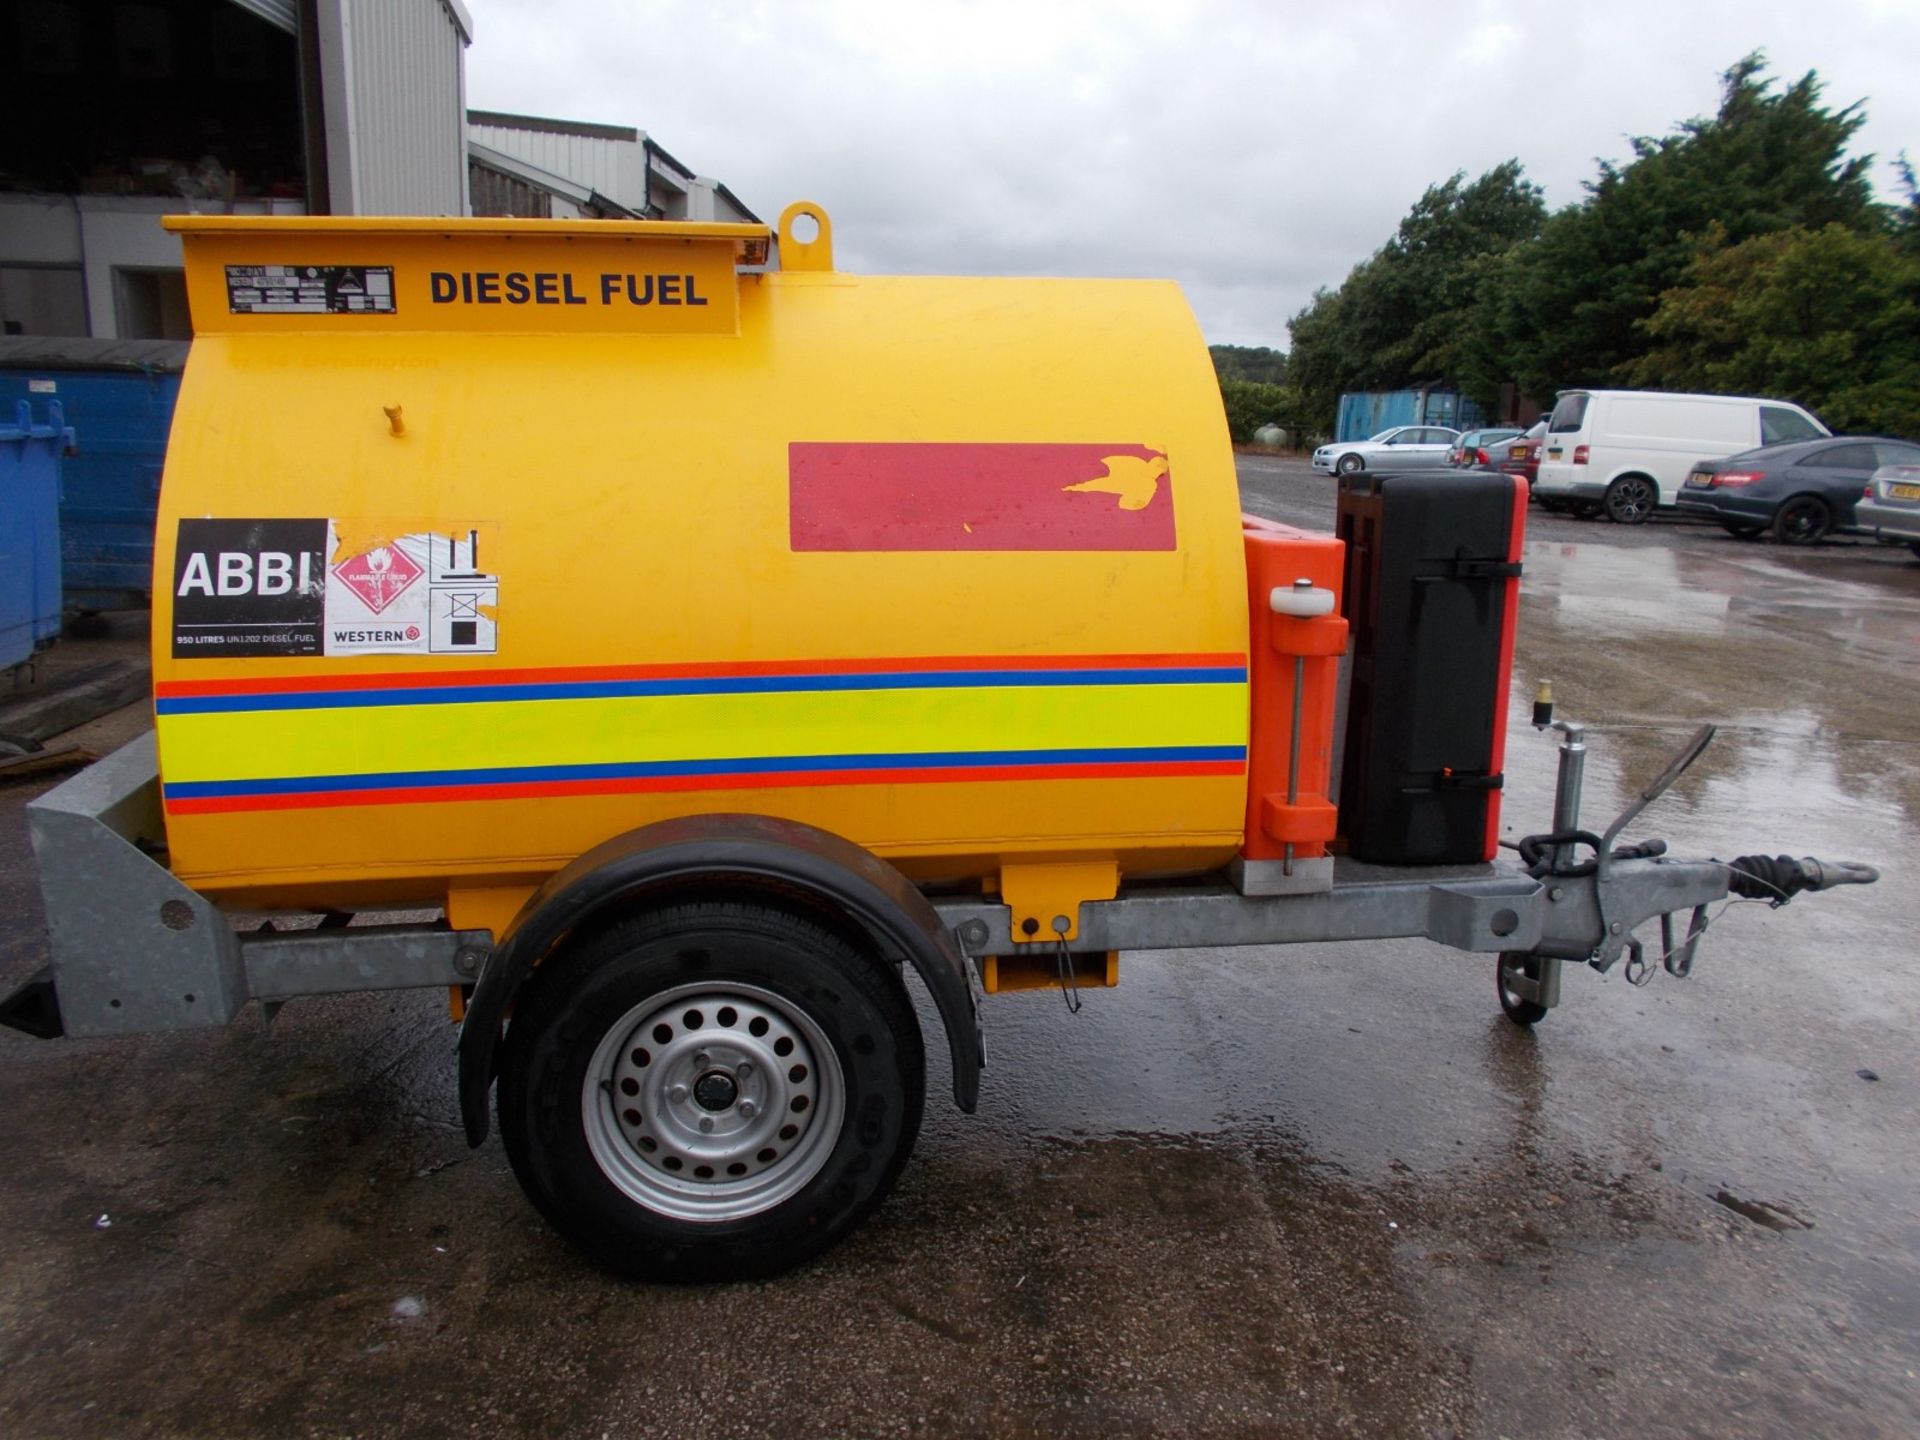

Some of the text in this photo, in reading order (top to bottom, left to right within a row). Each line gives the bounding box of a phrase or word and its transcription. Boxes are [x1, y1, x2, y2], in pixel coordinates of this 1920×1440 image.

[430, 271, 708, 306] DIESEL FUEL
[177, 552, 312, 597] ABBI
[177, 634, 316, 645] 950 LITRES UN1202 DIESEL FUEL
[334, 630, 403, 642] WESTERN
